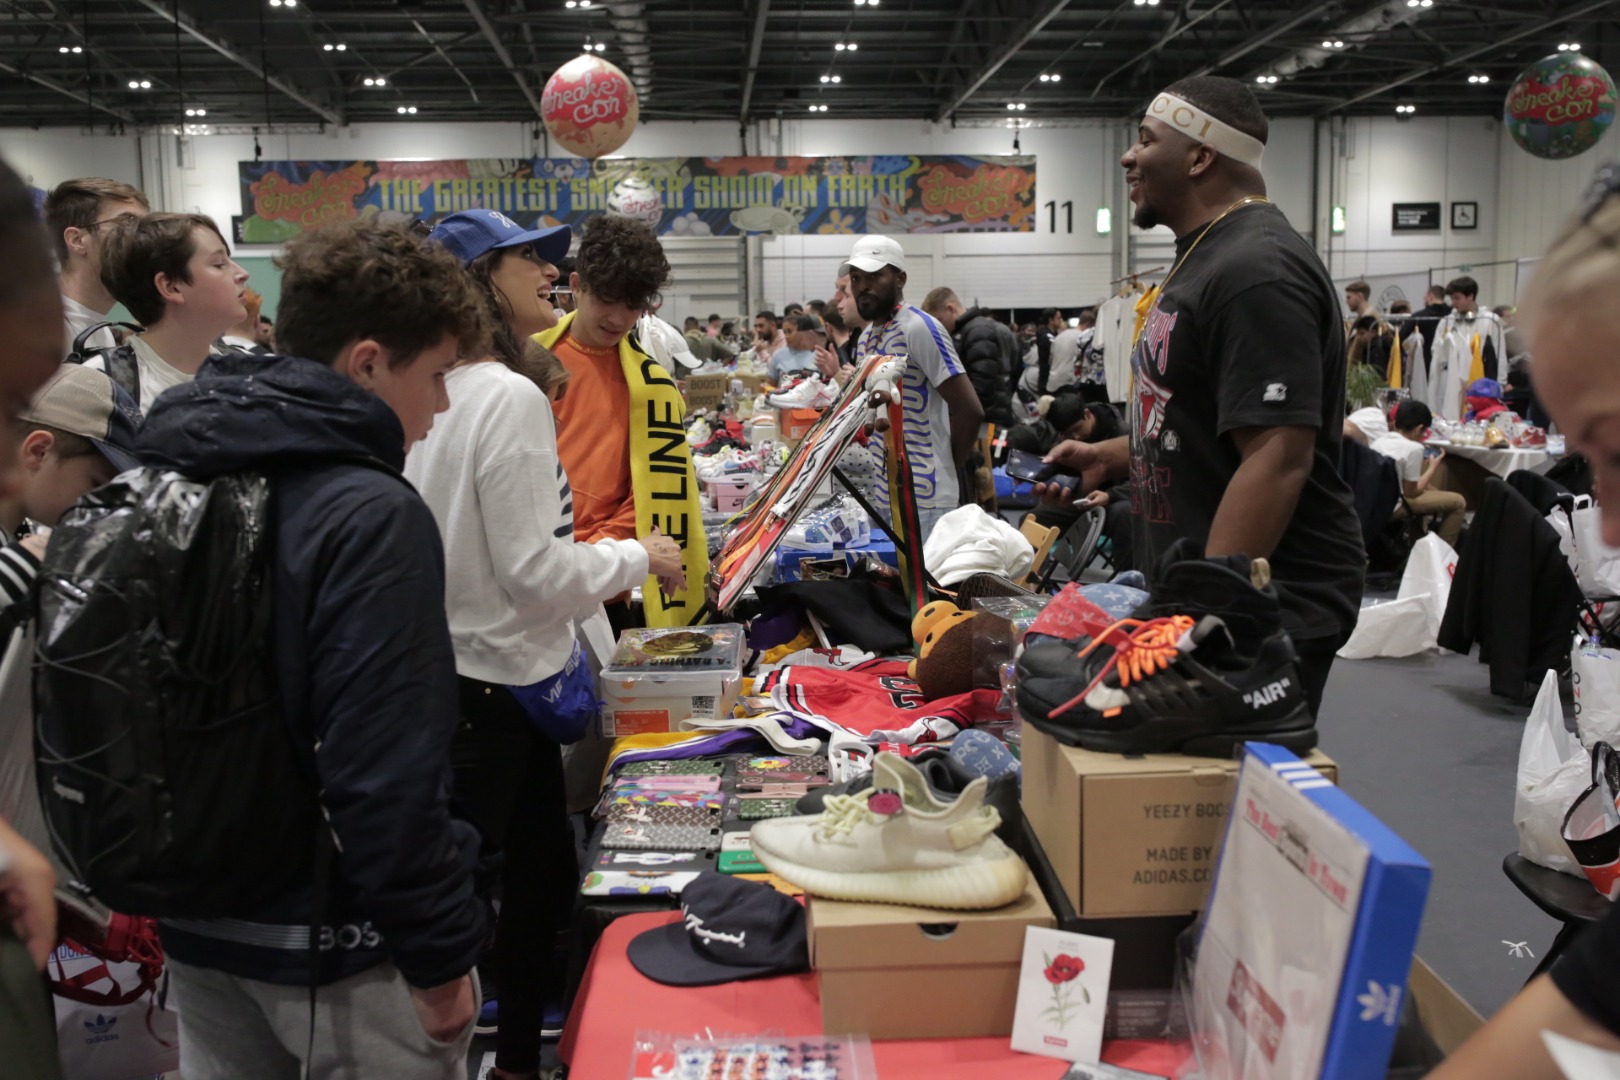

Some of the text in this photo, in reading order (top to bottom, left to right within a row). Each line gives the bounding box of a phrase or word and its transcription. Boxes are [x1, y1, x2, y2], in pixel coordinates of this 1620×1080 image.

[378, 180, 423, 212] THE
[433, 178, 559, 212] GREATEST
[693, 175, 774, 209] SHOW
[783, 175, 818, 208] ON
[827, 174, 907, 209] EARTH
[1044, 200, 1073, 233] 11
[690, 379, 722, 390] BOOST
[647, 398, 688, 501] LINE
[1243, 677, 1291, 710] "AIR"
[1143, 804, 1191, 819] YEEZY
[1146, 846, 1213, 862] MADE BY
[1132, 869, 1212, 884] ADIDAS.CO
